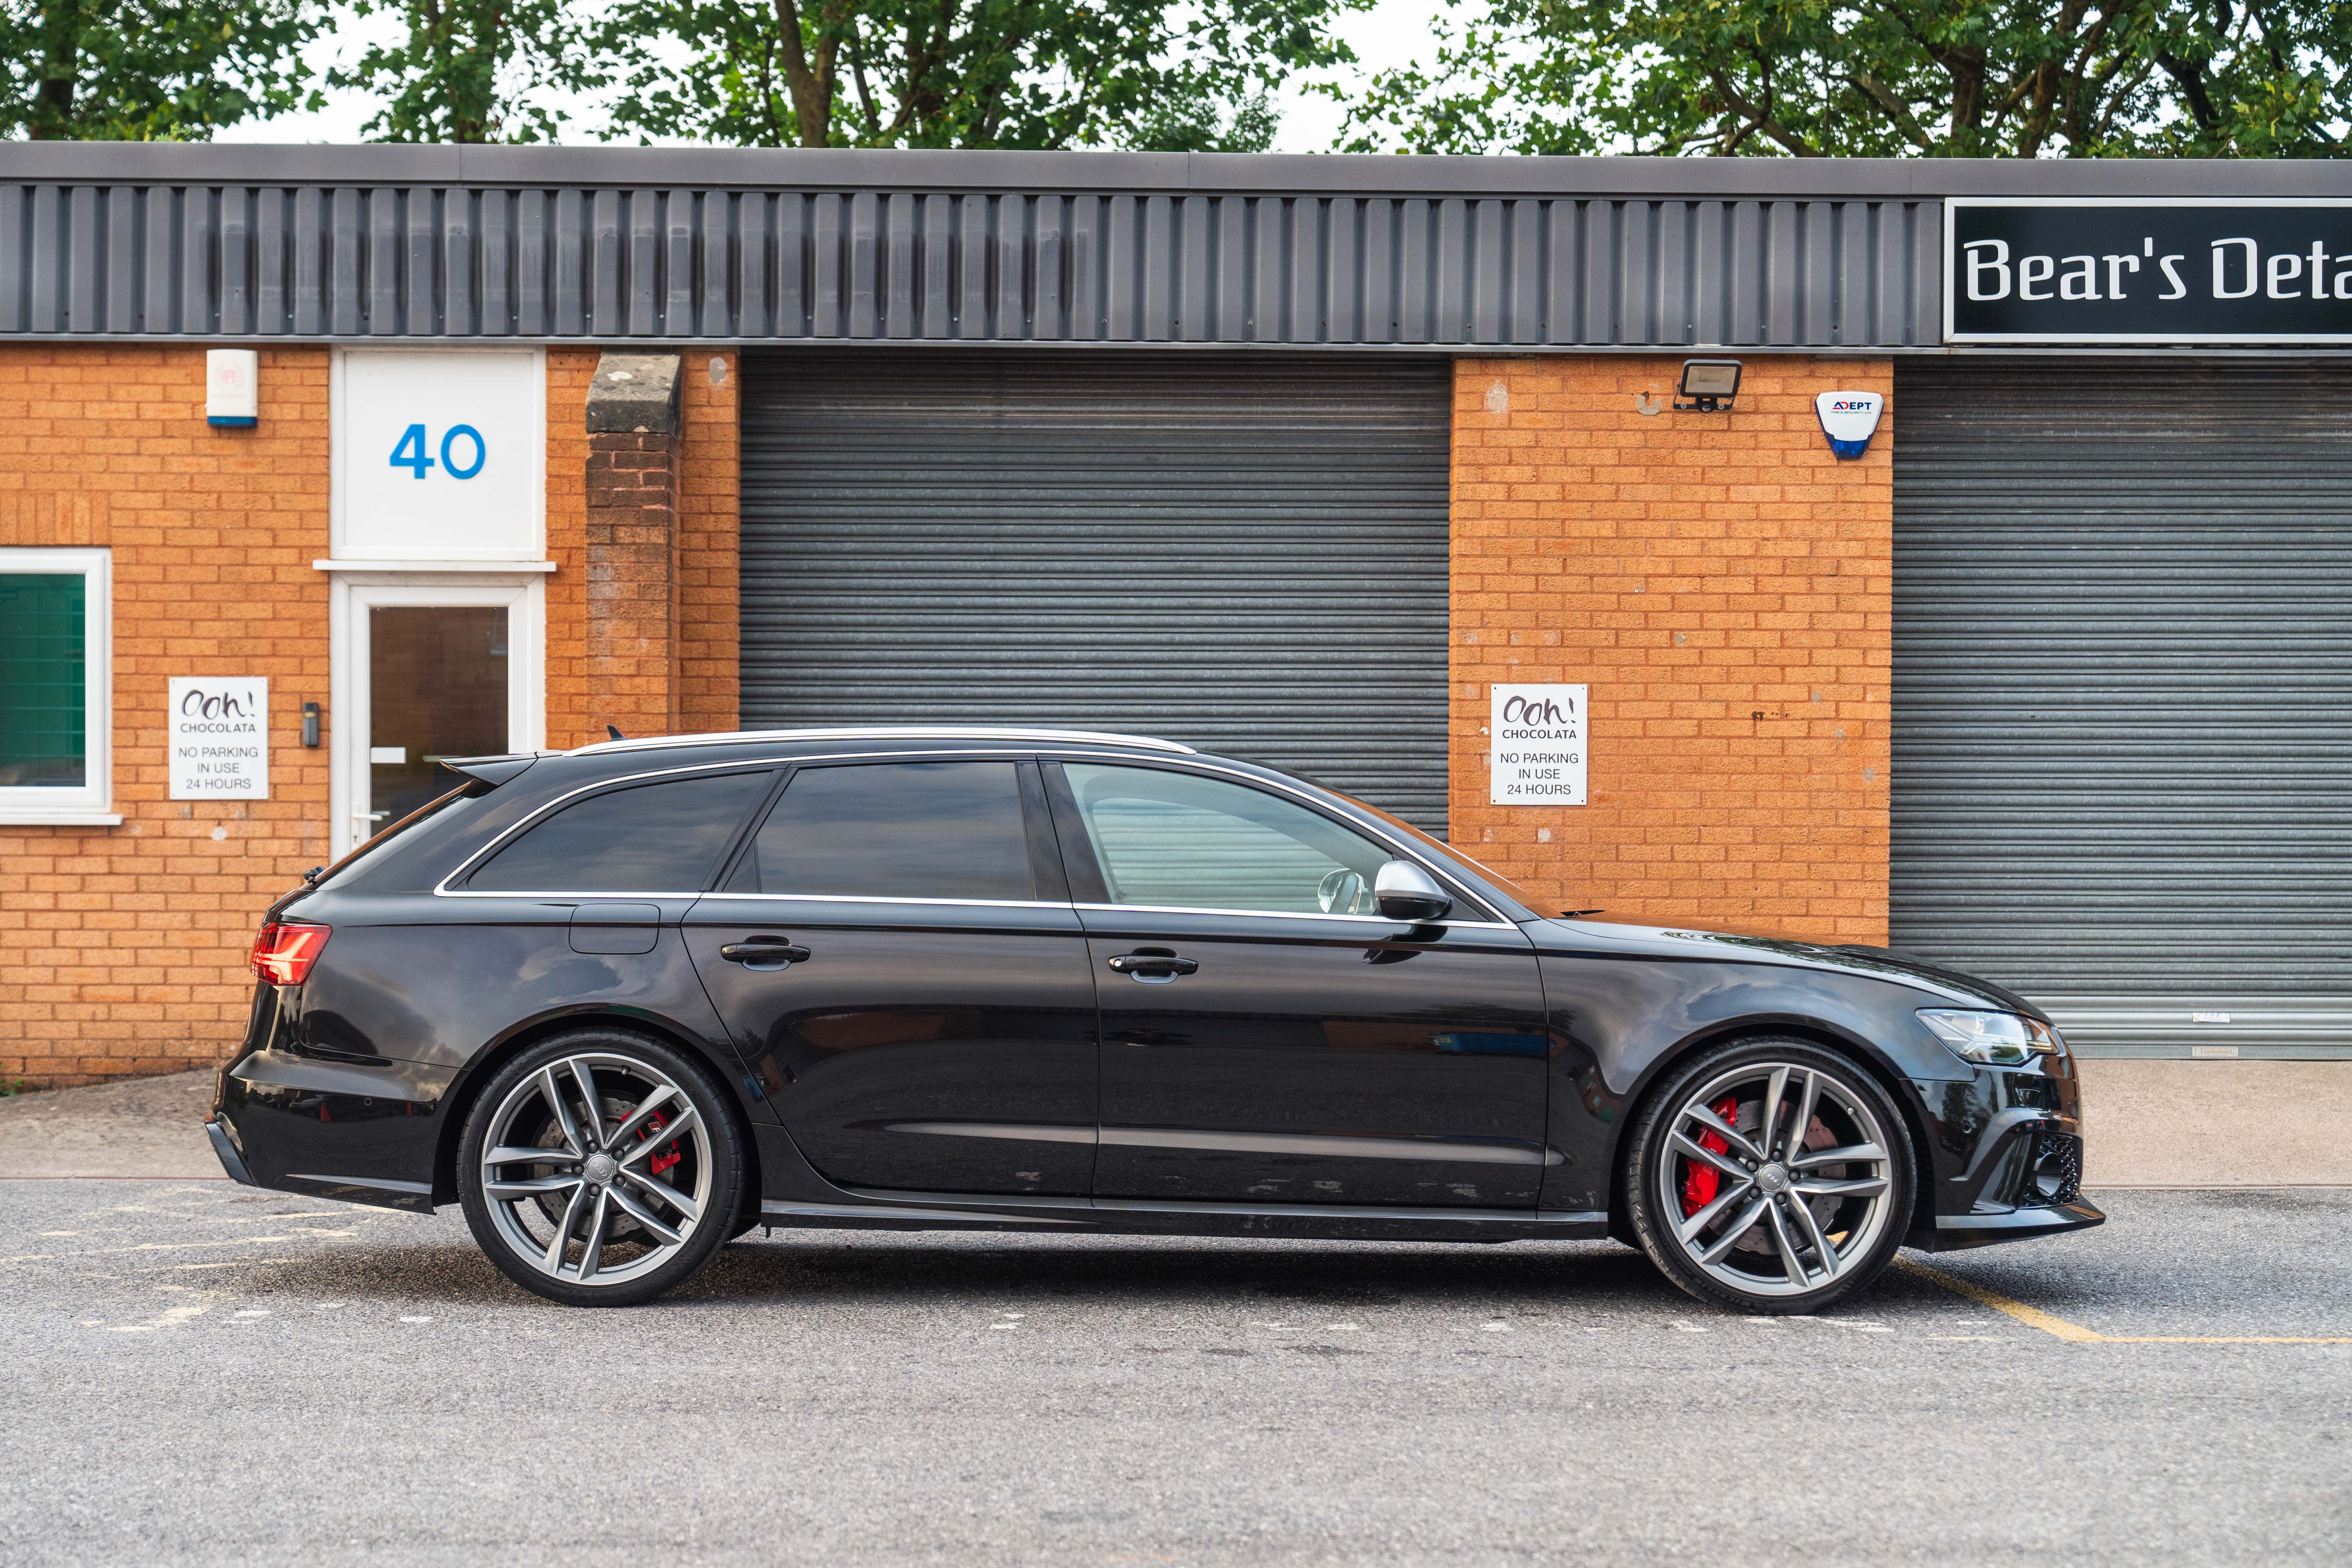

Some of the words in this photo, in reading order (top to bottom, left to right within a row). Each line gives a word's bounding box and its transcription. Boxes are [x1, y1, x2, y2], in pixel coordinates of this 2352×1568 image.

[1963, 237, 2186, 301] Bear's
[1832, 401, 1872, 410] ADEPT
[389, 424, 486, 480] 40
[182, 689, 255, 720] Ooh!
[1503, 695, 1576, 726] Ooh!
[180, 723, 256, 733] CHOCOLATA
[1502, 729, 1577, 739] CHOCOLATA
[179, 747, 197, 758] NO
[202, 747, 258, 758] PARKING
[1500, 753, 1519, 763] NO
[1524, 753, 1579, 764] PARKING
[198, 763, 209, 773] IN
[214, 763, 239, 773] USE
[1519, 769, 1530, 779] IN
[1535, 769, 1560, 779] USE
[186, 779, 200, 789] 24
[205, 779, 251, 789] HOURS
[1507, 784, 1521, 794] 24
[1526, 784, 1571, 795] HOURS
[1692, 1277, 1752, 1307] MICHELIN
